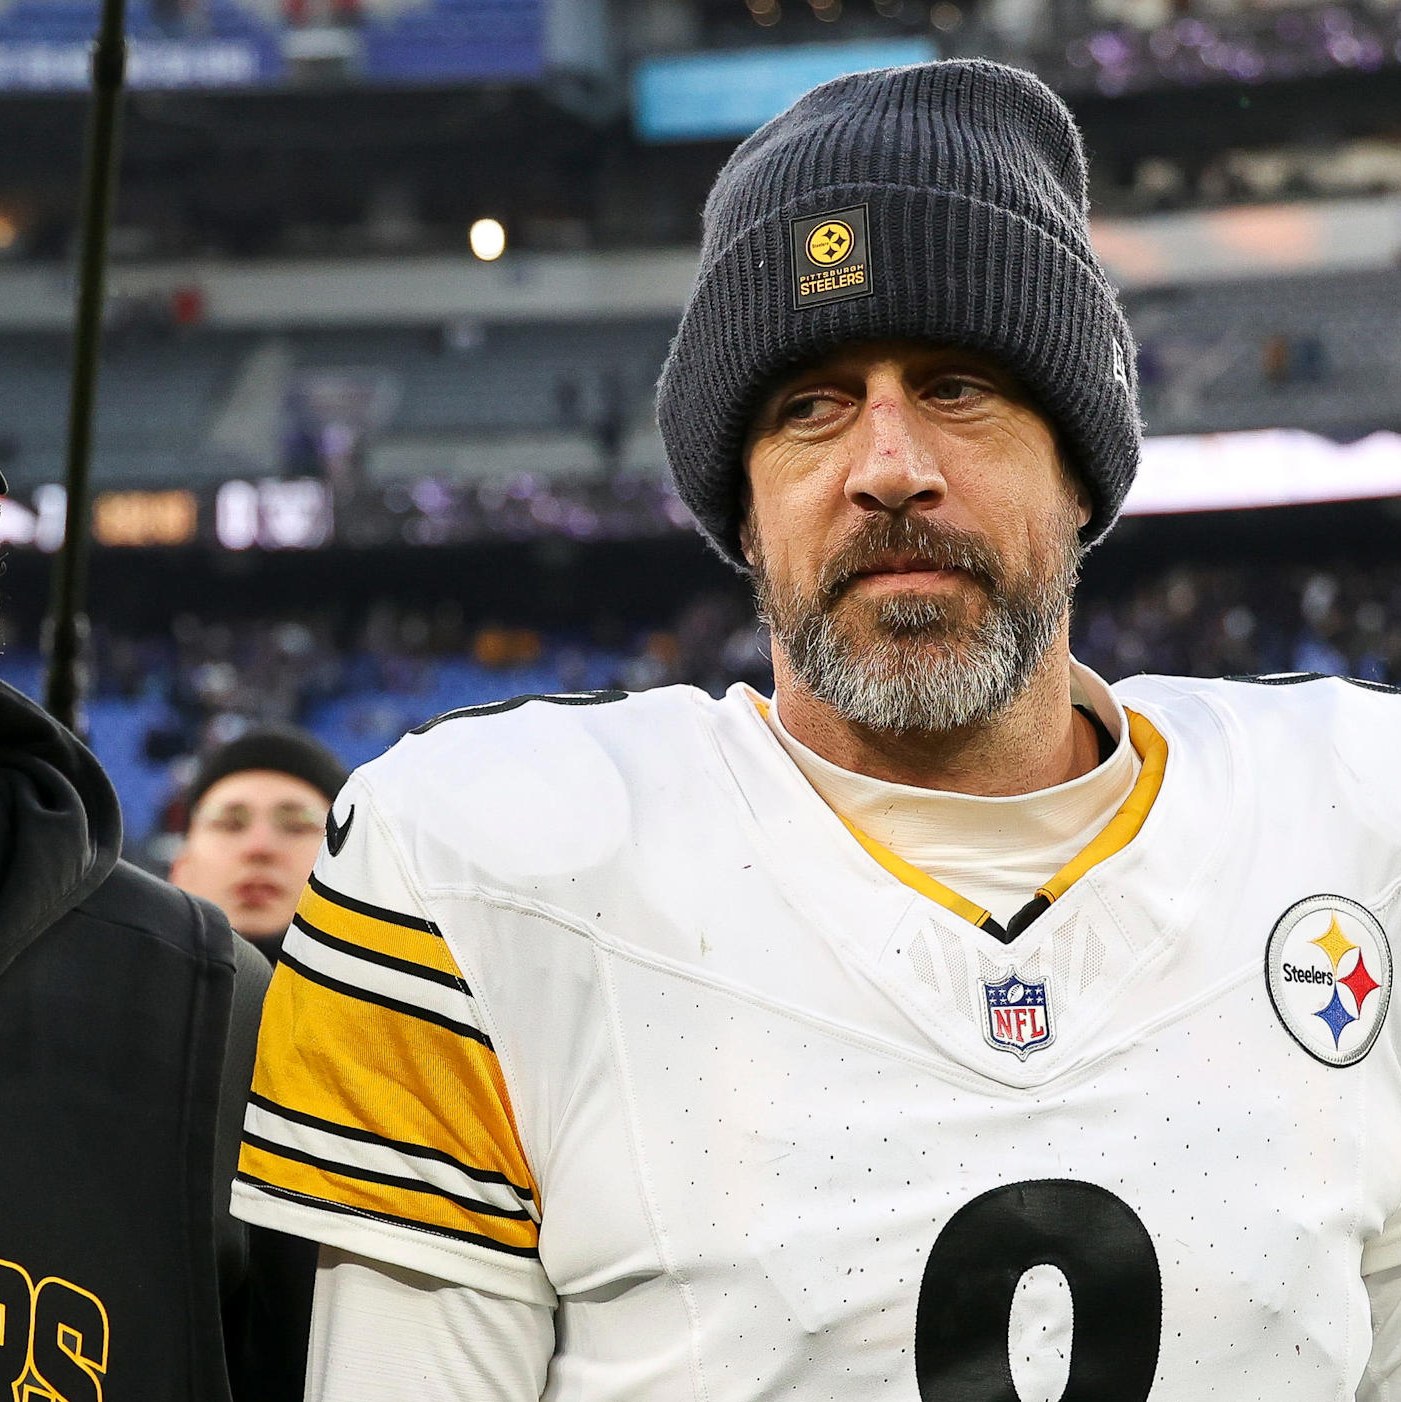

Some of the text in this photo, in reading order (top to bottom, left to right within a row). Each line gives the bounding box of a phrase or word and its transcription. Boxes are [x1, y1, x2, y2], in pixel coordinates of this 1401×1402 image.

[799, 263, 865, 283] PITTSBURGH
[800, 270, 865, 296] STEELERS
[1282, 962, 1334, 987] Steelers
[993, 1008, 1045, 1043] NFL
